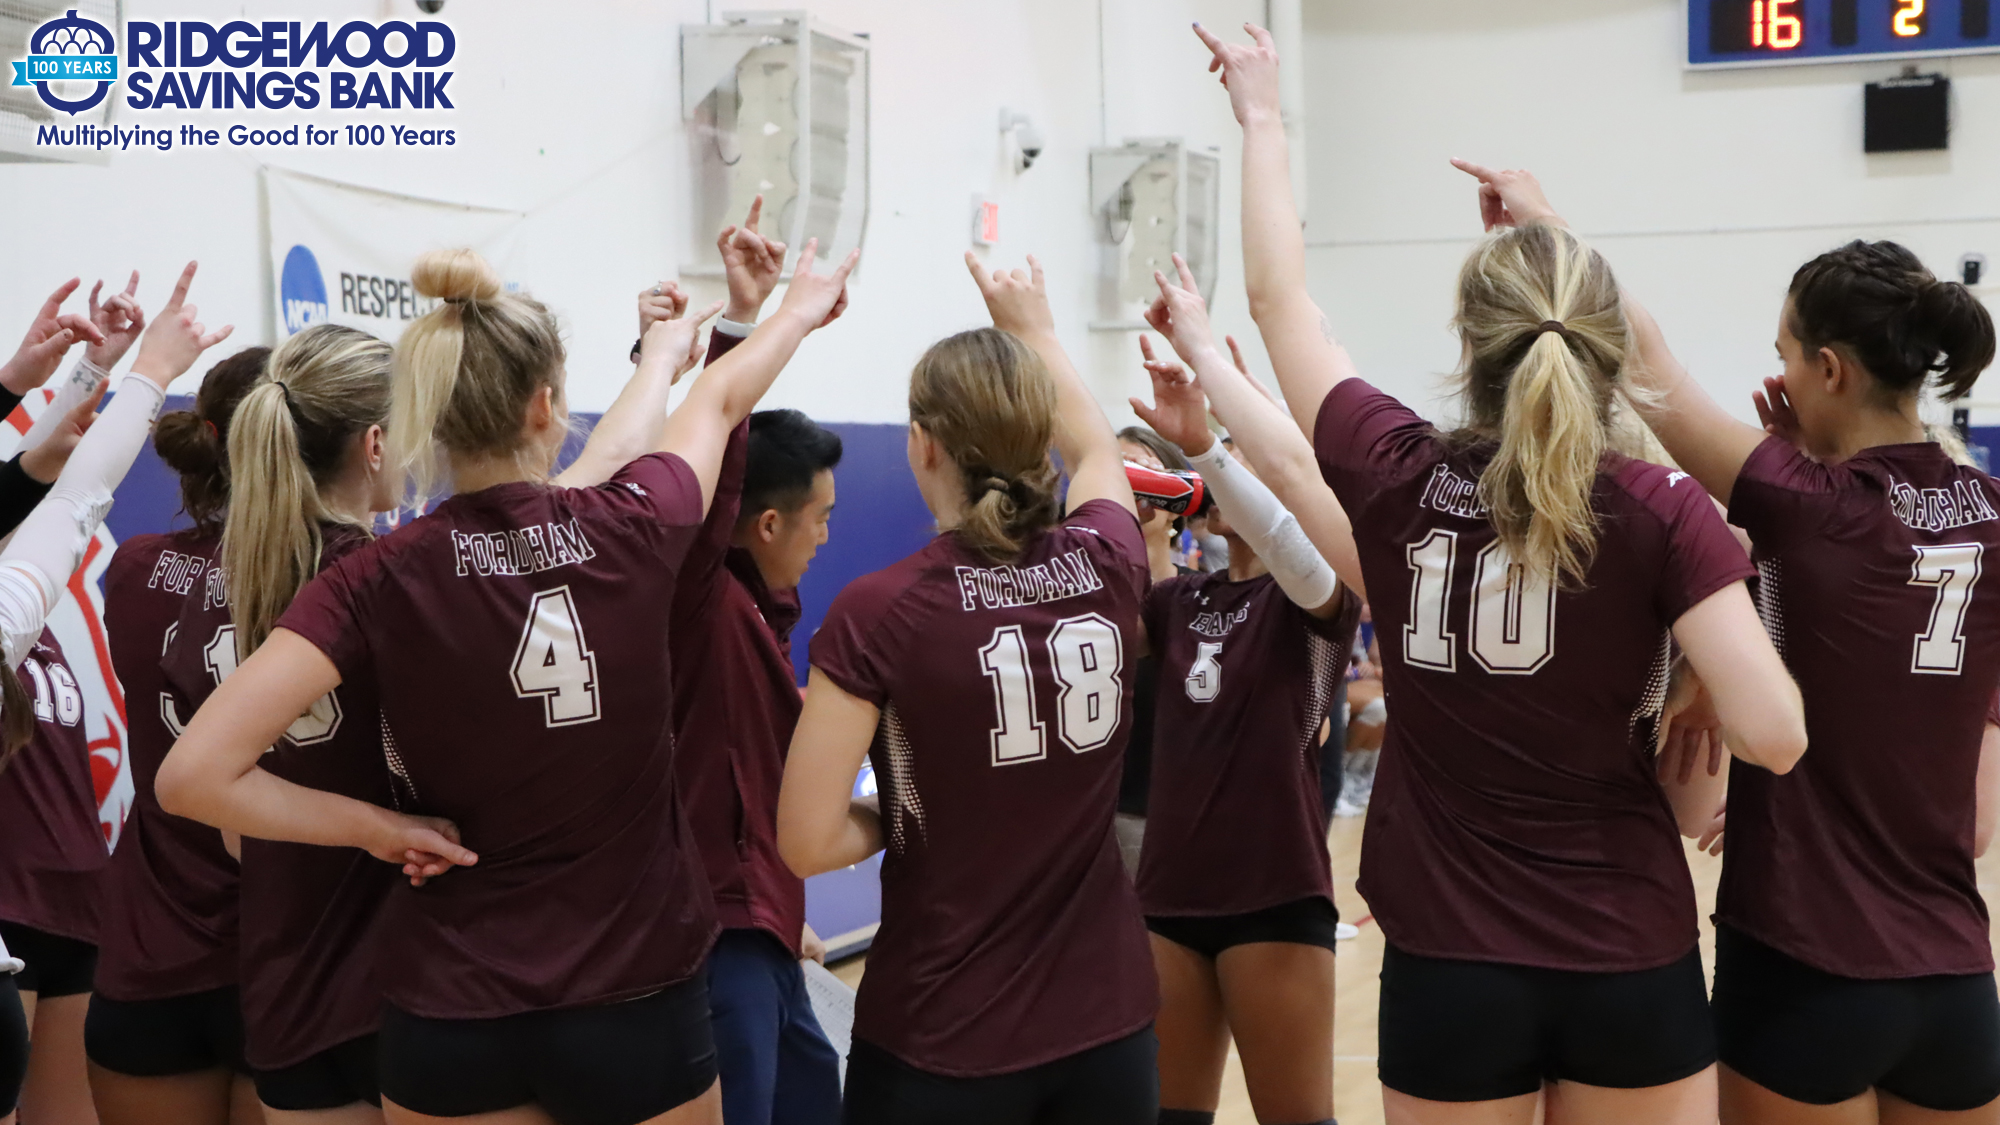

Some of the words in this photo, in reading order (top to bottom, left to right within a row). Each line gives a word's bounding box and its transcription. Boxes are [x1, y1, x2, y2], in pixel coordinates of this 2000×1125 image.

[1749, 0, 1801, 48] 16
[1893, 0, 1924, 36] 2
[452, 517, 597, 577] FORDHAM
[955, 547, 1104, 611] FORDHAM
[1403, 528, 1558, 675] 10
[1907, 542, 1984, 675] 7
[509, 584, 601, 728] 4
[978, 612, 1123, 767] 18
[1185, 641, 1223, 703] 5
[25, 657, 81, 727] 16
